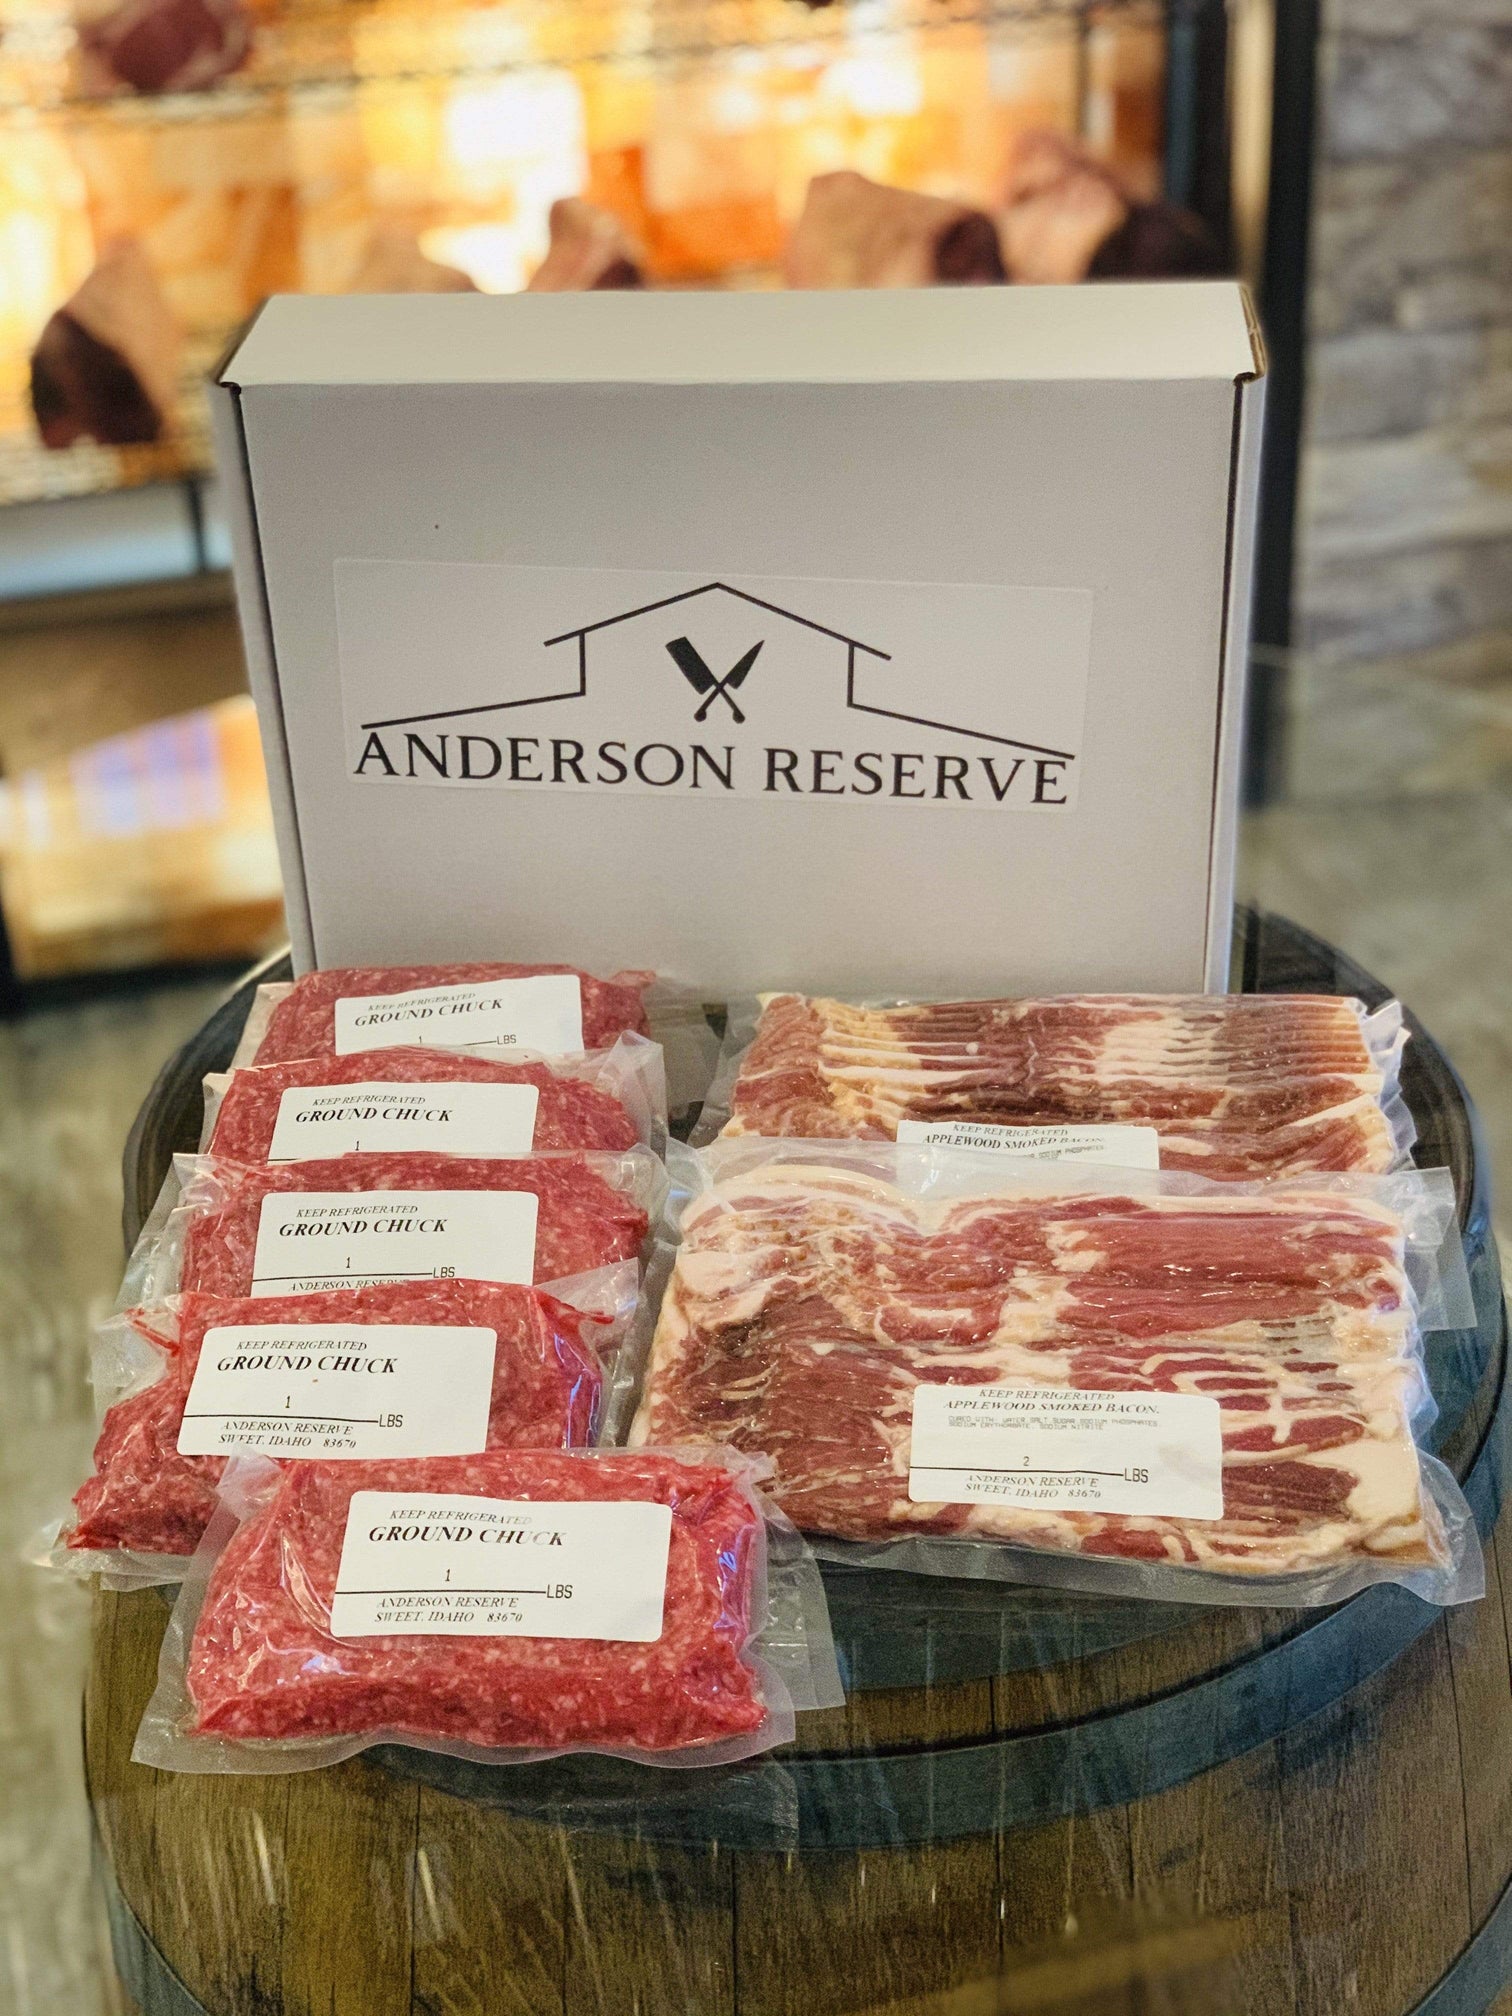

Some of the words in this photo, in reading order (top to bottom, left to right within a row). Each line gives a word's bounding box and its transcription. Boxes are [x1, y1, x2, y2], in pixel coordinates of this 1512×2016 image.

[353, 732, 736, 790] ANDERSON
[765, 748, 1069, 805] RESERVE
[397, 992, 476, 1009] REFRIGERATED
[355, 1008, 433, 1027] GROUND
[438, 998, 503, 1016] CHUCK
[418, 1035, 423, 1044] 1
[497, 1034, 518, 1046] LBS
[312, 1096, 342, 1106] KEEP
[341, 1094, 426, 1105] REFRIGERATED
[296, 1107, 378, 1123] GROUND
[383, 1107, 454, 1122] CHUCK
[952, 1123, 983, 1134] KEEP
[983, 1125, 1069, 1137] REFRIGERATED
[355, 1141, 361, 1151] 1
[923, 1134, 1002, 1149] APPLEWOOD
[1003, 1137, 1058, 1149] SMOKED
[296, 1207, 328, 1218] KEEP
[328, 1205, 419, 1217] REFRIGERATED
[279, 1219, 368, 1237] GROUND
[373, 1218, 449, 1233] CHUCK
[346, 1257, 351, 1269] 1
[433, 1266, 456, 1279] LBS
[288, 1279, 354, 1292] ANDERSON
[236, 1340, 270, 1351] KEEP
[272, 1340, 368, 1351] REFRIGERATED
[217, 1355, 312, 1372] GROUND
[317, 1355, 399, 1374] CHUCK
[979, 1388, 1014, 1399] KEEP
[1015, 1389, 1116, 1401] REFRIGERATED
[284, 1396, 291, 1409] 1
[379, 1413, 404, 1428] LBS
[943, 1400, 1036, 1411] APPLEWOOD
[1039, 1402, 1103, 1411] SMOKED
[222, 1420, 293, 1431] ANDERSON
[294, 1422, 354, 1435] RESERVE
[268, 1435, 312, 1447] IDAHO
[323, 1439, 357, 1448] 83670
[1023, 1456, 1030, 1467] 2
[1124, 1467, 1149, 1483] LBS
[967, 1474, 1038, 1486] ANDERSON
[1039, 1476, 1100, 1488] RESERVE
[1015, 1487, 1060, 1498] IDAHO
[1067, 1488, 1101, 1499] 83670
[389, 1509, 426, 1521] KEEP
[427, 1510, 533, 1526] REFRIGERATED
[369, 1525, 473, 1542] GROUND
[479, 1527, 568, 1546] CHUCK
[444, 1568, 451, 1581] 1
[546, 1583, 573, 1599] LBS
[376, 1596, 454, 1608] ANDERSON
[455, 1596, 519, 1608] RESERVE
[428, 1611, 475, 1623] IDAHO
[487, 1612, 523, 1623] 83670
